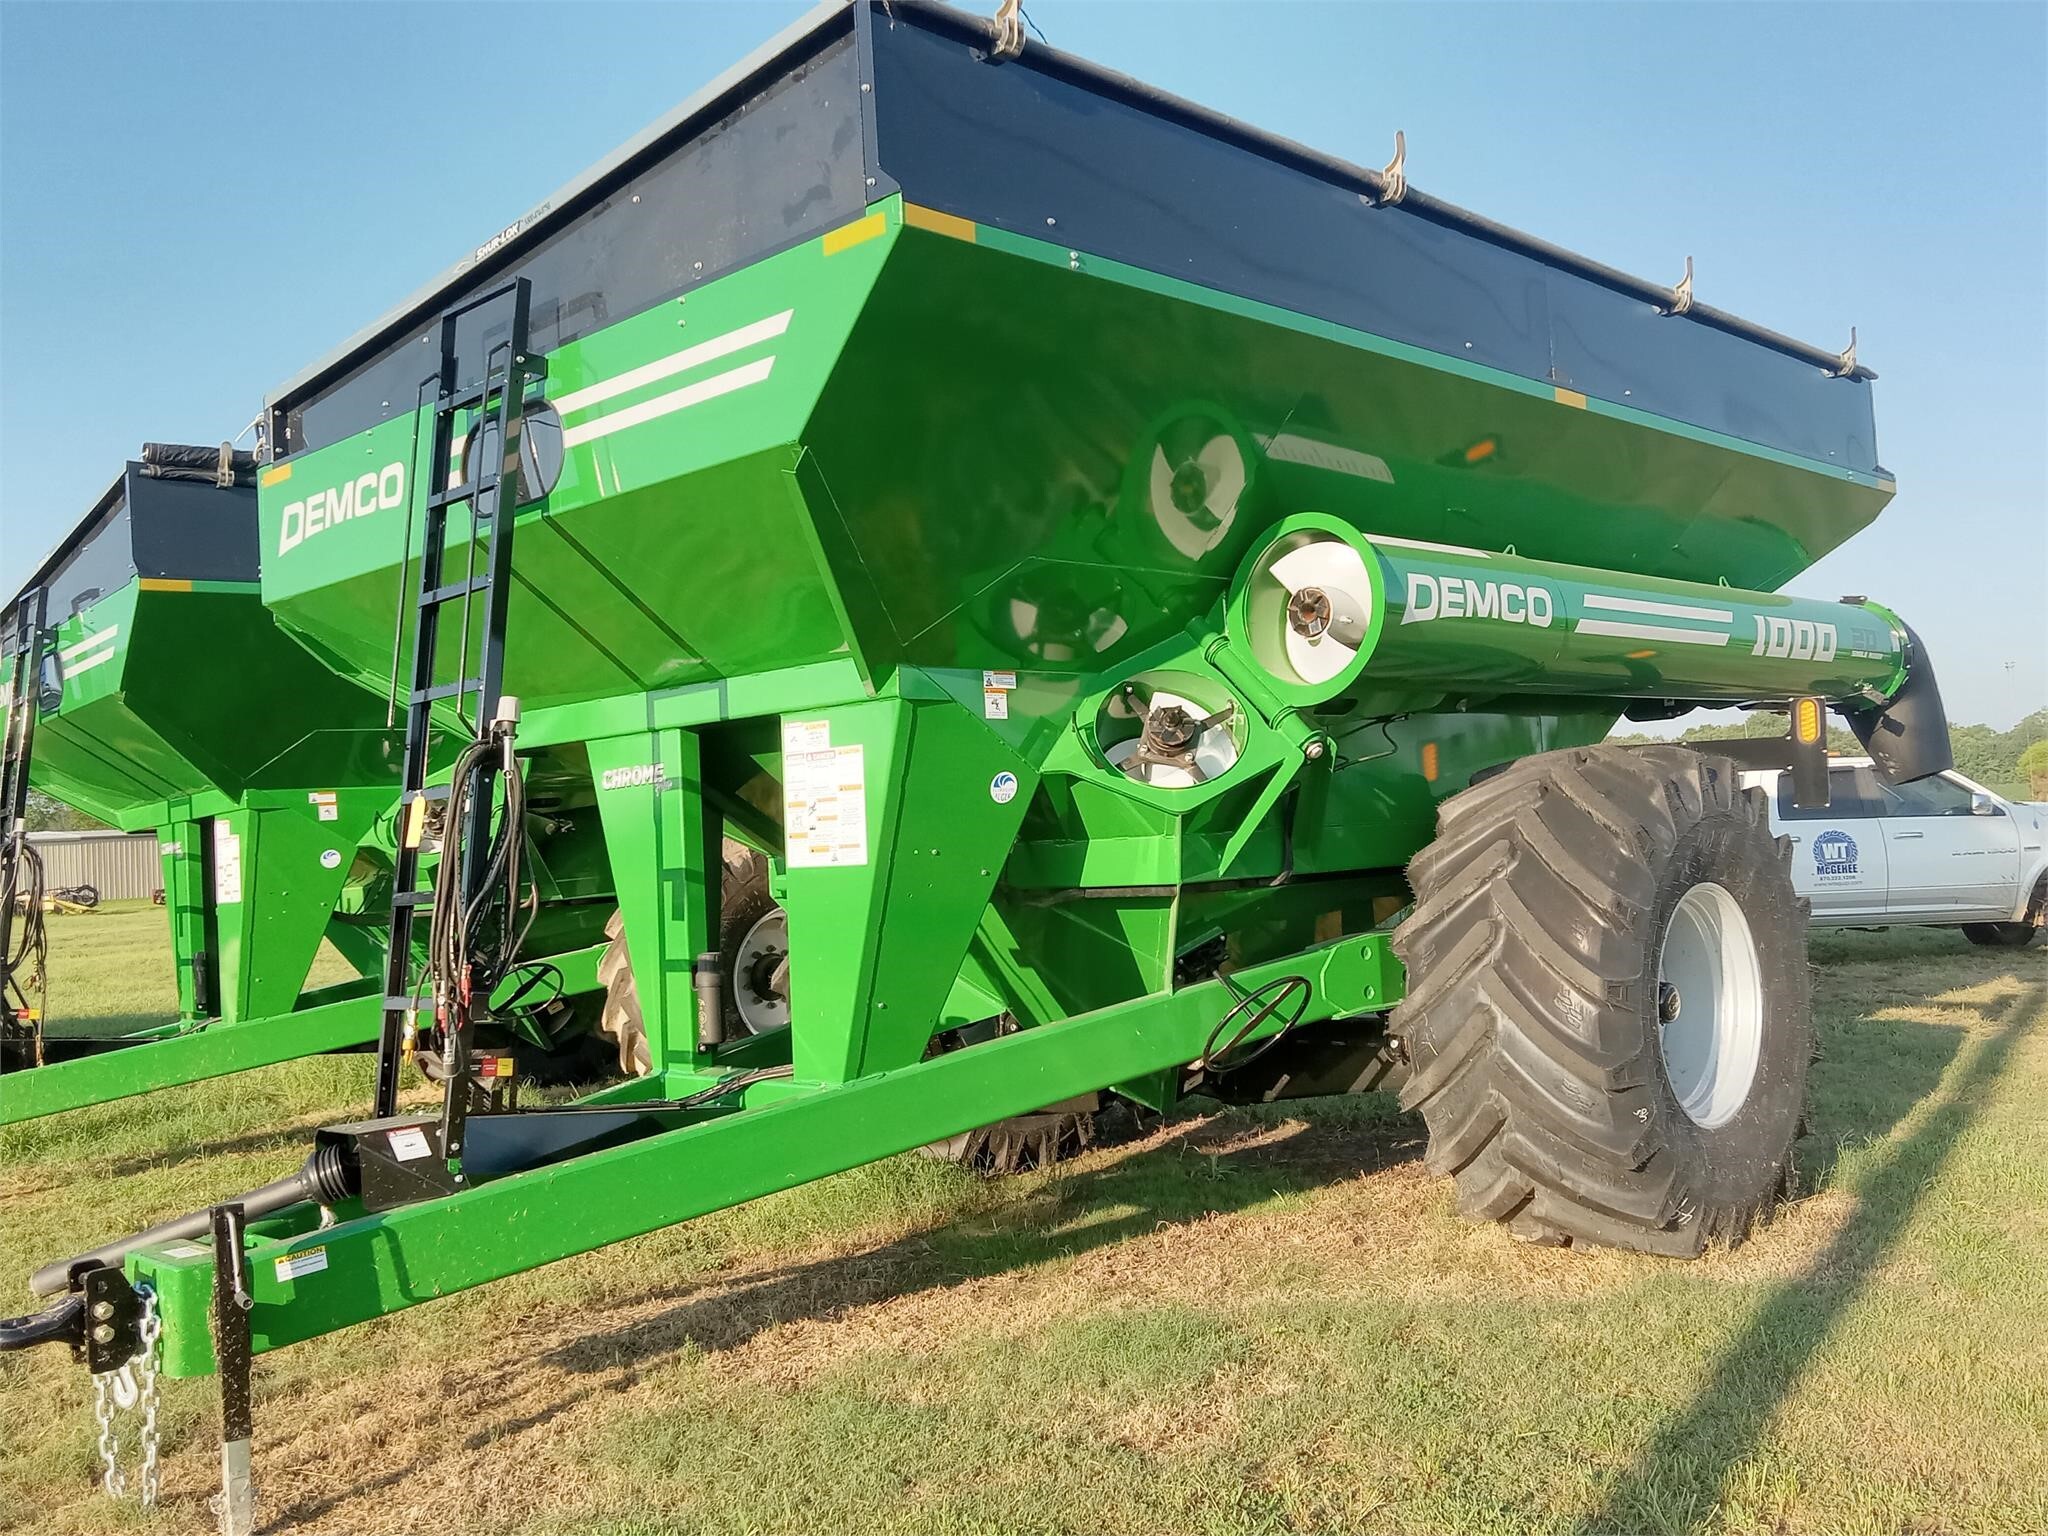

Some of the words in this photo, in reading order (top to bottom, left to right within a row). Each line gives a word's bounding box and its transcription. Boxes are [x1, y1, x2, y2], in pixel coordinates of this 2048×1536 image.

[475, 221, 520, 262] SHUR-LOK
[278, 461, 405, 558] DEMCO
[1400, 572, 1553, 628] DEMCO
[1751, 614, 1838, 663] 1000
[602, 763, 665, 791] CHROME
[1822, 842, 1848, 859] WT
[285, 1247, 323, 1262] CAUTION
